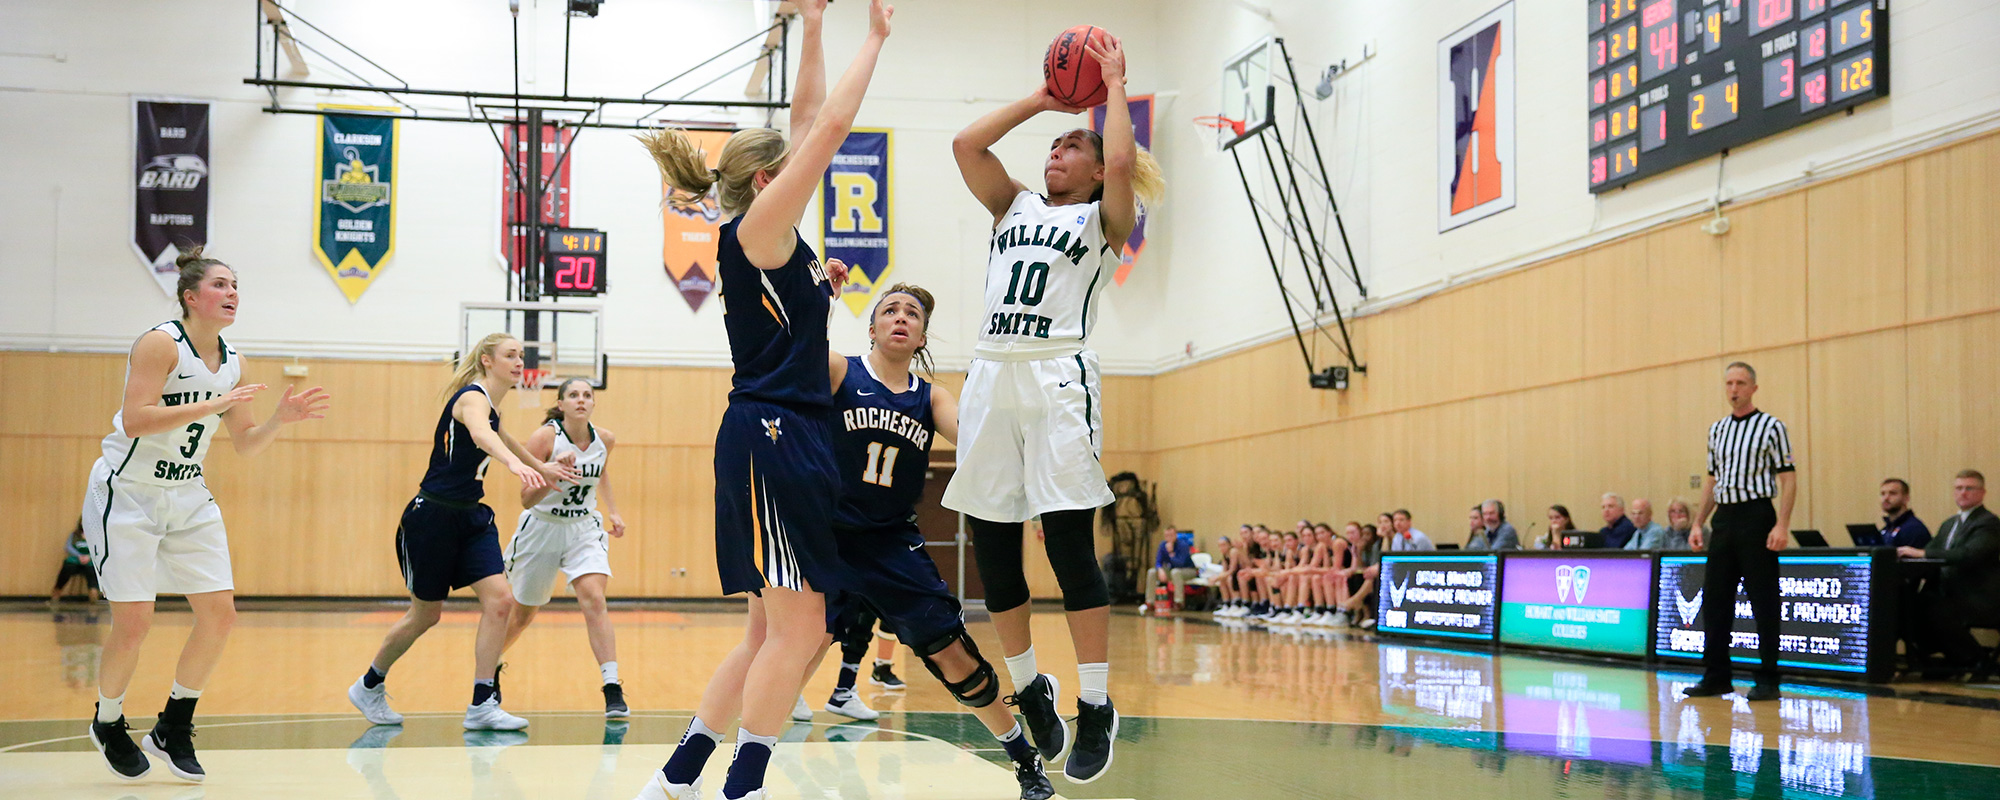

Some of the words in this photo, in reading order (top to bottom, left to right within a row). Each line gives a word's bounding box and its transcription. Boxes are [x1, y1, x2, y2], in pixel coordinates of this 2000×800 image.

[1708, 12, 1721, 43] 4
[1057, 32, 1077, 71] NCAA
[1649, 22, 1679, 70] 44
[1779, 58, 1794, 97] 3
[160, 126, 187, 139] BARD
[333, 132, 382, 147] CLARKSON
[139, 169, 202, 190] BARD
[830, 171, 883, 233] R
[149, 213, 194, 226] RAPTORS
[337, 219, 373, 231] GOLDEN
[334, 230, 376, 243] KNIGHTS
[562, 234, 601, 251] 4:11
[681, 231, 712, 243] TIGERS
[824, 237, 889, 249] YELLOWJACKETS
[997, 224, 1089, 266] WILLIAM
[554, 256, 596, 289] 20
[1003, 260, 1051, 308] 10
[988, 311, 1053, 340] SMITH
[180, 422, 205, 459] 3
[842, 406, 929, 452] ROCHESTER
[862, 441, 900, 488] 11
[1793, 601, 1861, 624] PROVIDER
